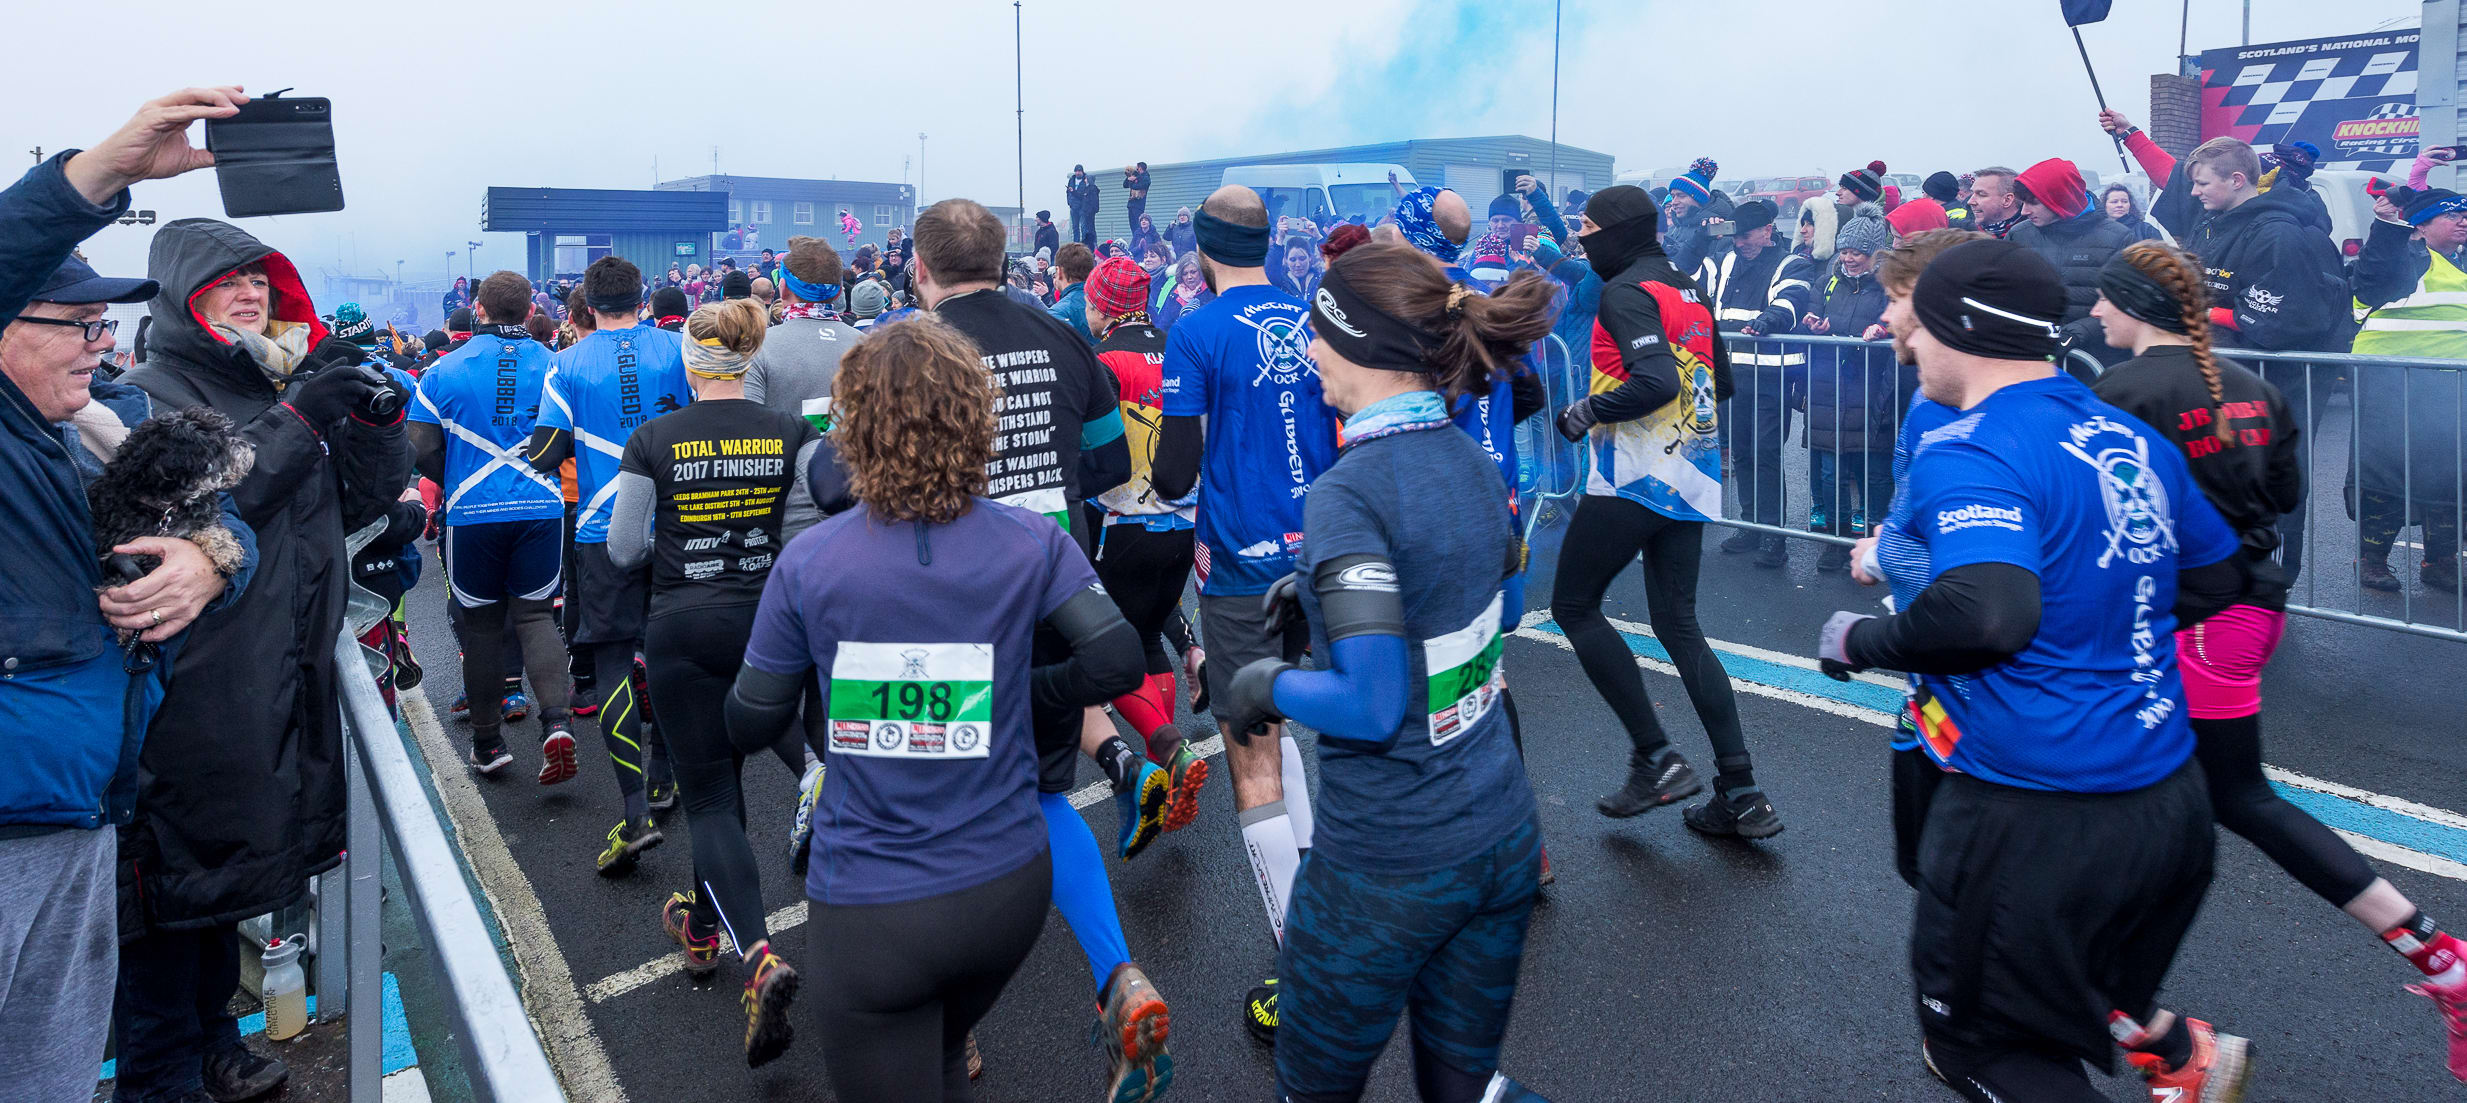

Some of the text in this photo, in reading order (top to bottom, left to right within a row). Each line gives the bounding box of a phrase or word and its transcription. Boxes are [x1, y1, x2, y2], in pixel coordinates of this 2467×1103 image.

[2238, 34, 2420, 60] SCOTLAND'S NATIONAL MO
[996, 350, 1050, 369] WHISPERS
[495, 358, 517, 414] GUBBED
[617, 354, 642, 414] GUBBED
[1009, 367, 1057, 386] WARRIOR
[1273, 371, 1301, 385] OCR
[1007, 394, 1030, 410] CAN
[1032, 391, 1052, 407] NOT
[491, 415, 517, 427] 2018
[994, 410, 1051, 432] ITHSTAND
[672, 439, 784, 460] TOTAL WARRIOR
[673, 458, 784, 482] 2017 FINISHER
[1006, 451, 1058, 472] WARRIOR
[988, 467, 1063, 495] HISPERS BACK
[673, 493, 690, 501] LEEDS
[691, 491, 719, 500] BRAMHAM
[689, 503, 703, 511] LAKE
[705, 501, 729, 510] DISTRICT
[730, 500, 740, 508] 5TH
[680, 514, 712, 523] EDINBURGH
[730, 511, 742, 519] 17TH
[743, 507, 771, 518] SEPTEMBER
[1937, 504, 2023, 527] Scotland
[739, 553, 772, 566] BATTLE
[748, 561, 772, 572] OATS
[872, 682, 952, 721] 198
[270, 988, 279, 1035] DIRECTION
